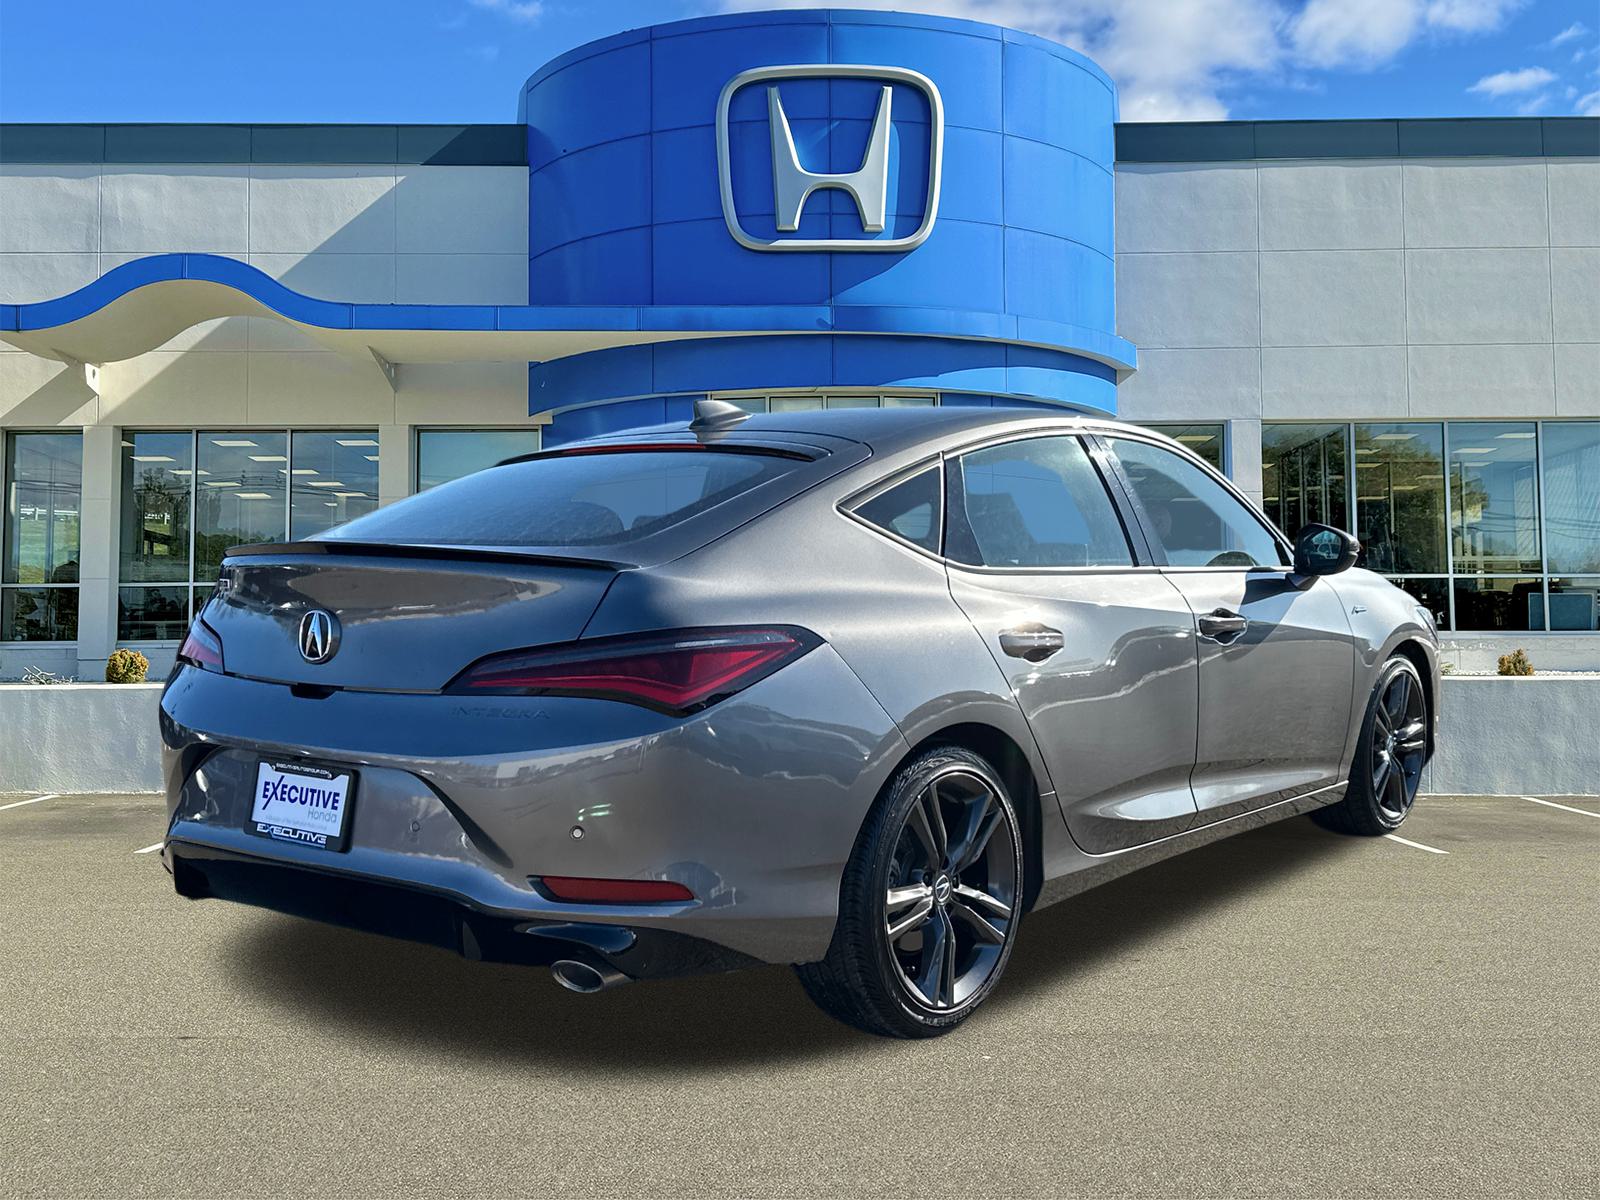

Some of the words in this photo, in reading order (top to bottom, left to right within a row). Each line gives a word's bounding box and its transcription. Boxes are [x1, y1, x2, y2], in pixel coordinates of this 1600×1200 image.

[450, 706, 551, 720] INTEGRA
[262, 775, 341, 811] EXECUTIVE
[307, 808, 338, 824] Honda
[256, 823, 328, 845] EXECUTIVE
